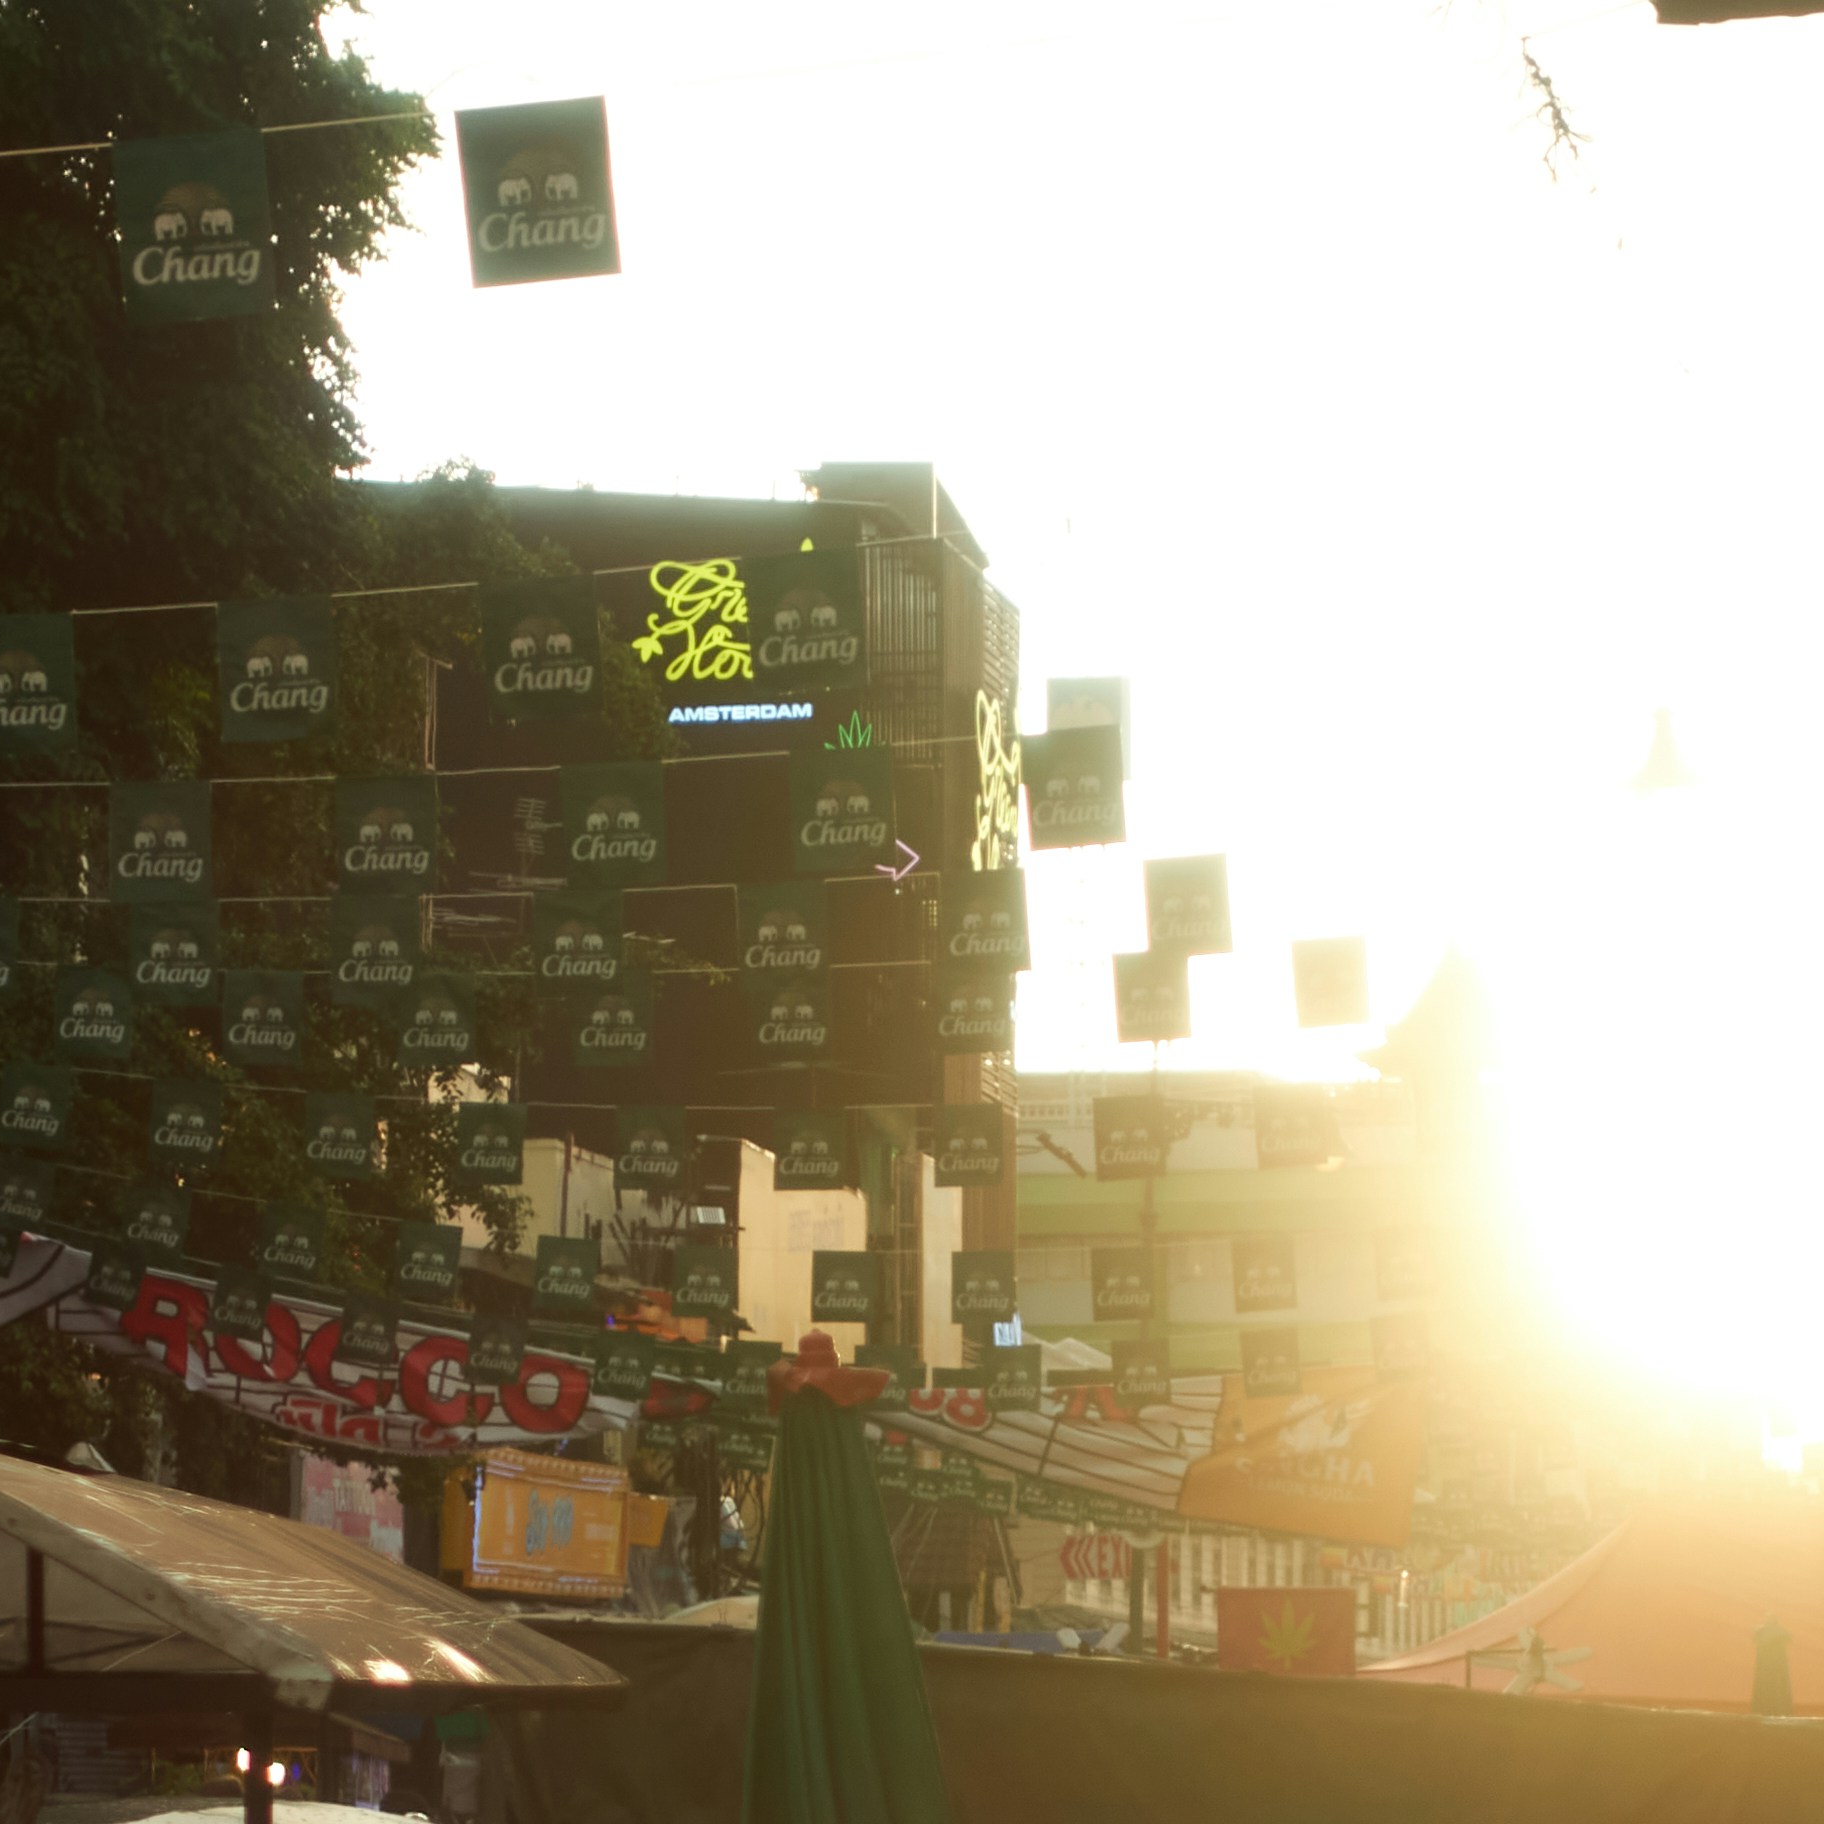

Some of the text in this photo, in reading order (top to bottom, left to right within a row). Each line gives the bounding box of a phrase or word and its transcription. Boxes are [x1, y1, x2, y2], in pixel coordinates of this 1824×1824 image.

[478, 207, 607, 254] Chang
[133, 244, 261, 287] Chang
[759, 632, 859, 670] Chang
[495, 660, 593, 696] Chang
[230, 680, 328, 715] Chang
[667, 702, 814, 724] AMSTERDAM
[801, 815, 887, 848] Chang
[344, 845, 430, 874] Chang
[571, 832, 658, 862] Chang
[118, 852, 204, 882] Chang
[542, 952, 617, 980] Chang
[745, 942, 821, 970] Chang
[136, 959, 212, 988] Chang
[338, 956, 414, 985] Chang
[59, 1016, 126, 1043] Chang
[228, 1022, 296, 1050] Chang
[403, 1026, 469, 1052] Chang
[580, 1025, 647, 1052] Chang
[759, 1021, 826, 1046] Chang
[1, 1109, 60, 1136] Chang
[154, 1126, 214, 1153] Chang
[307, 1141, 366, 1166] Chang
[461, 1148, 517, 1171] Chang
[619, 1154, 679, 1179] Chang
[127, 1222, 180, 1249] Chang
[263, 1244, 317, 1271] Chang
[400, 1262, 454, 1288] Chang
[537, 1273, 591, 1299] Chang
[726, 1378, 768, 1396] Chan
